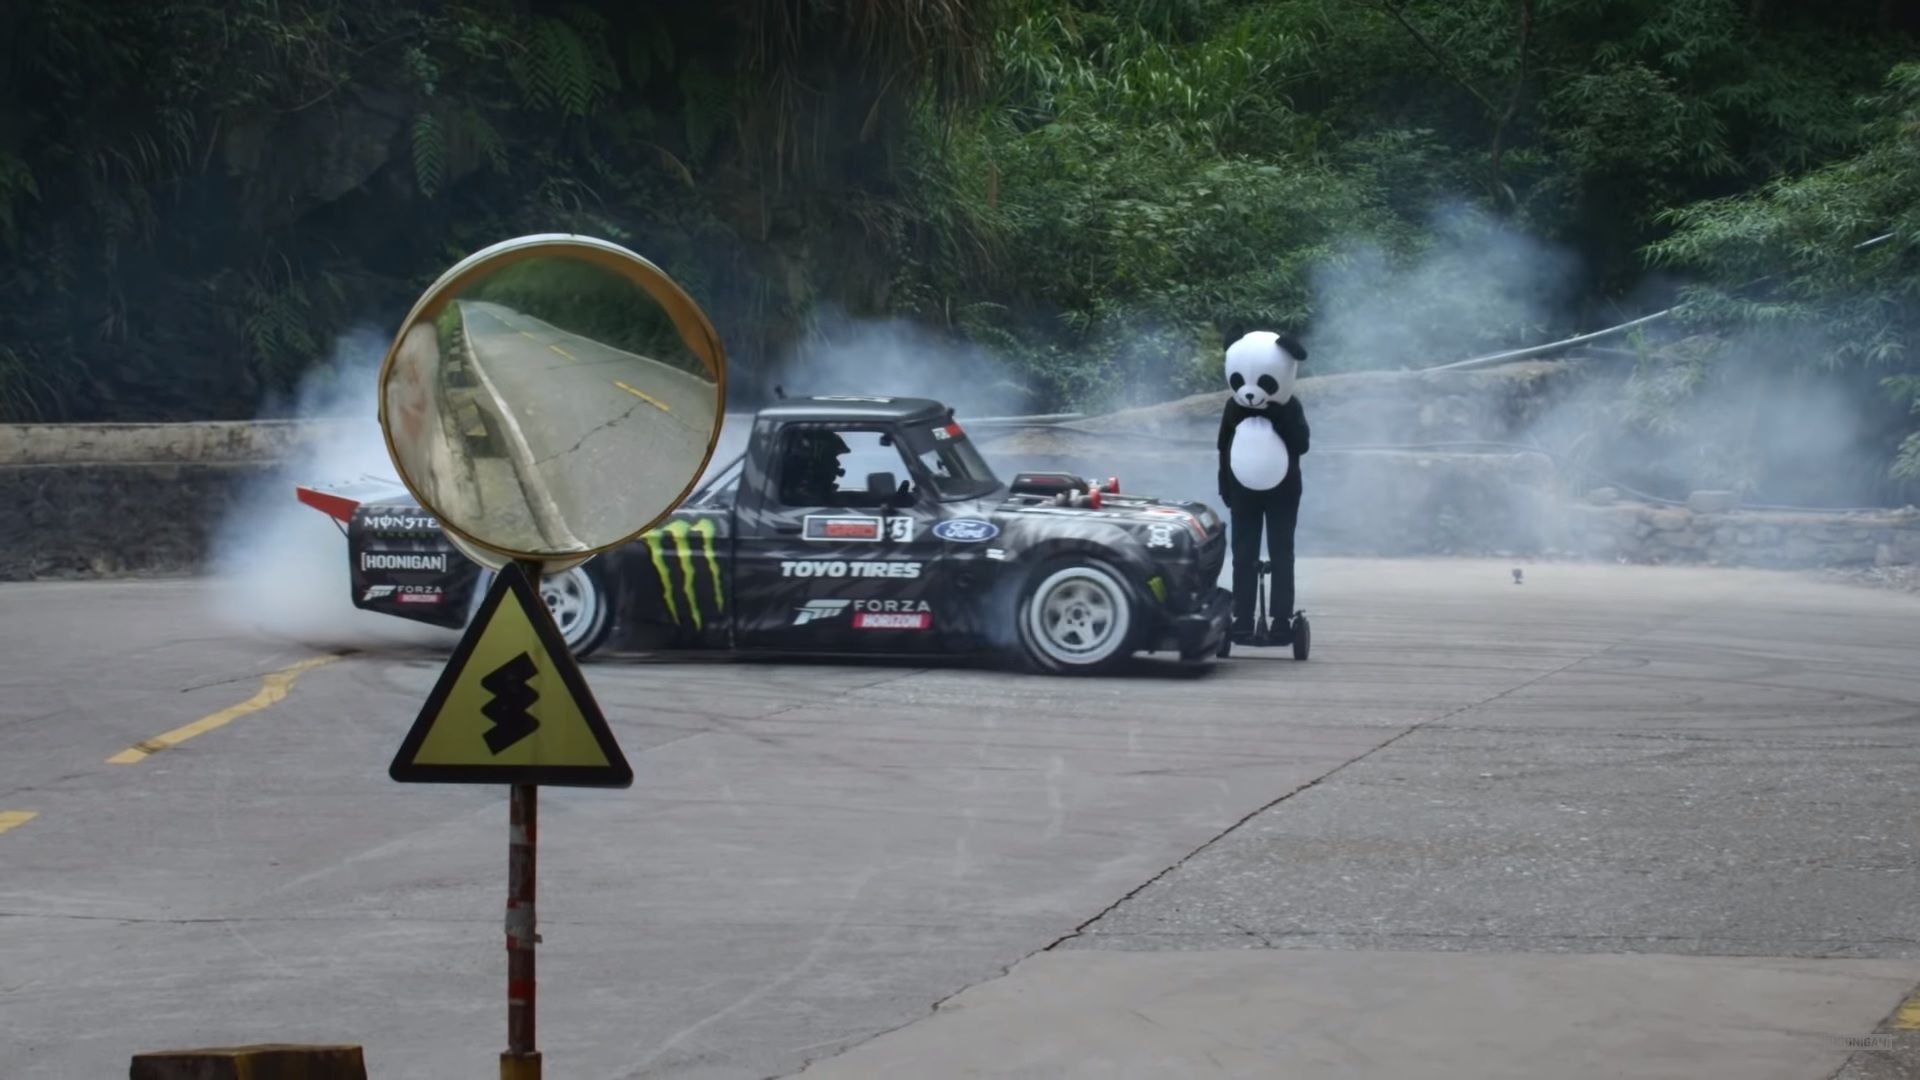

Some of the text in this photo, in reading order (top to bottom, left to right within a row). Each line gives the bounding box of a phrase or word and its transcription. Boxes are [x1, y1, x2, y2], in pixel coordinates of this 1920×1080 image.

[364, 515, 440, 529] MONSTE
[945, 521, 987, 537] Ford
[781, 562, 922, 578] TOYO TIRES
[397, 585, 442, 593] FORZA
[854, 600, 930, 612] FORZA
